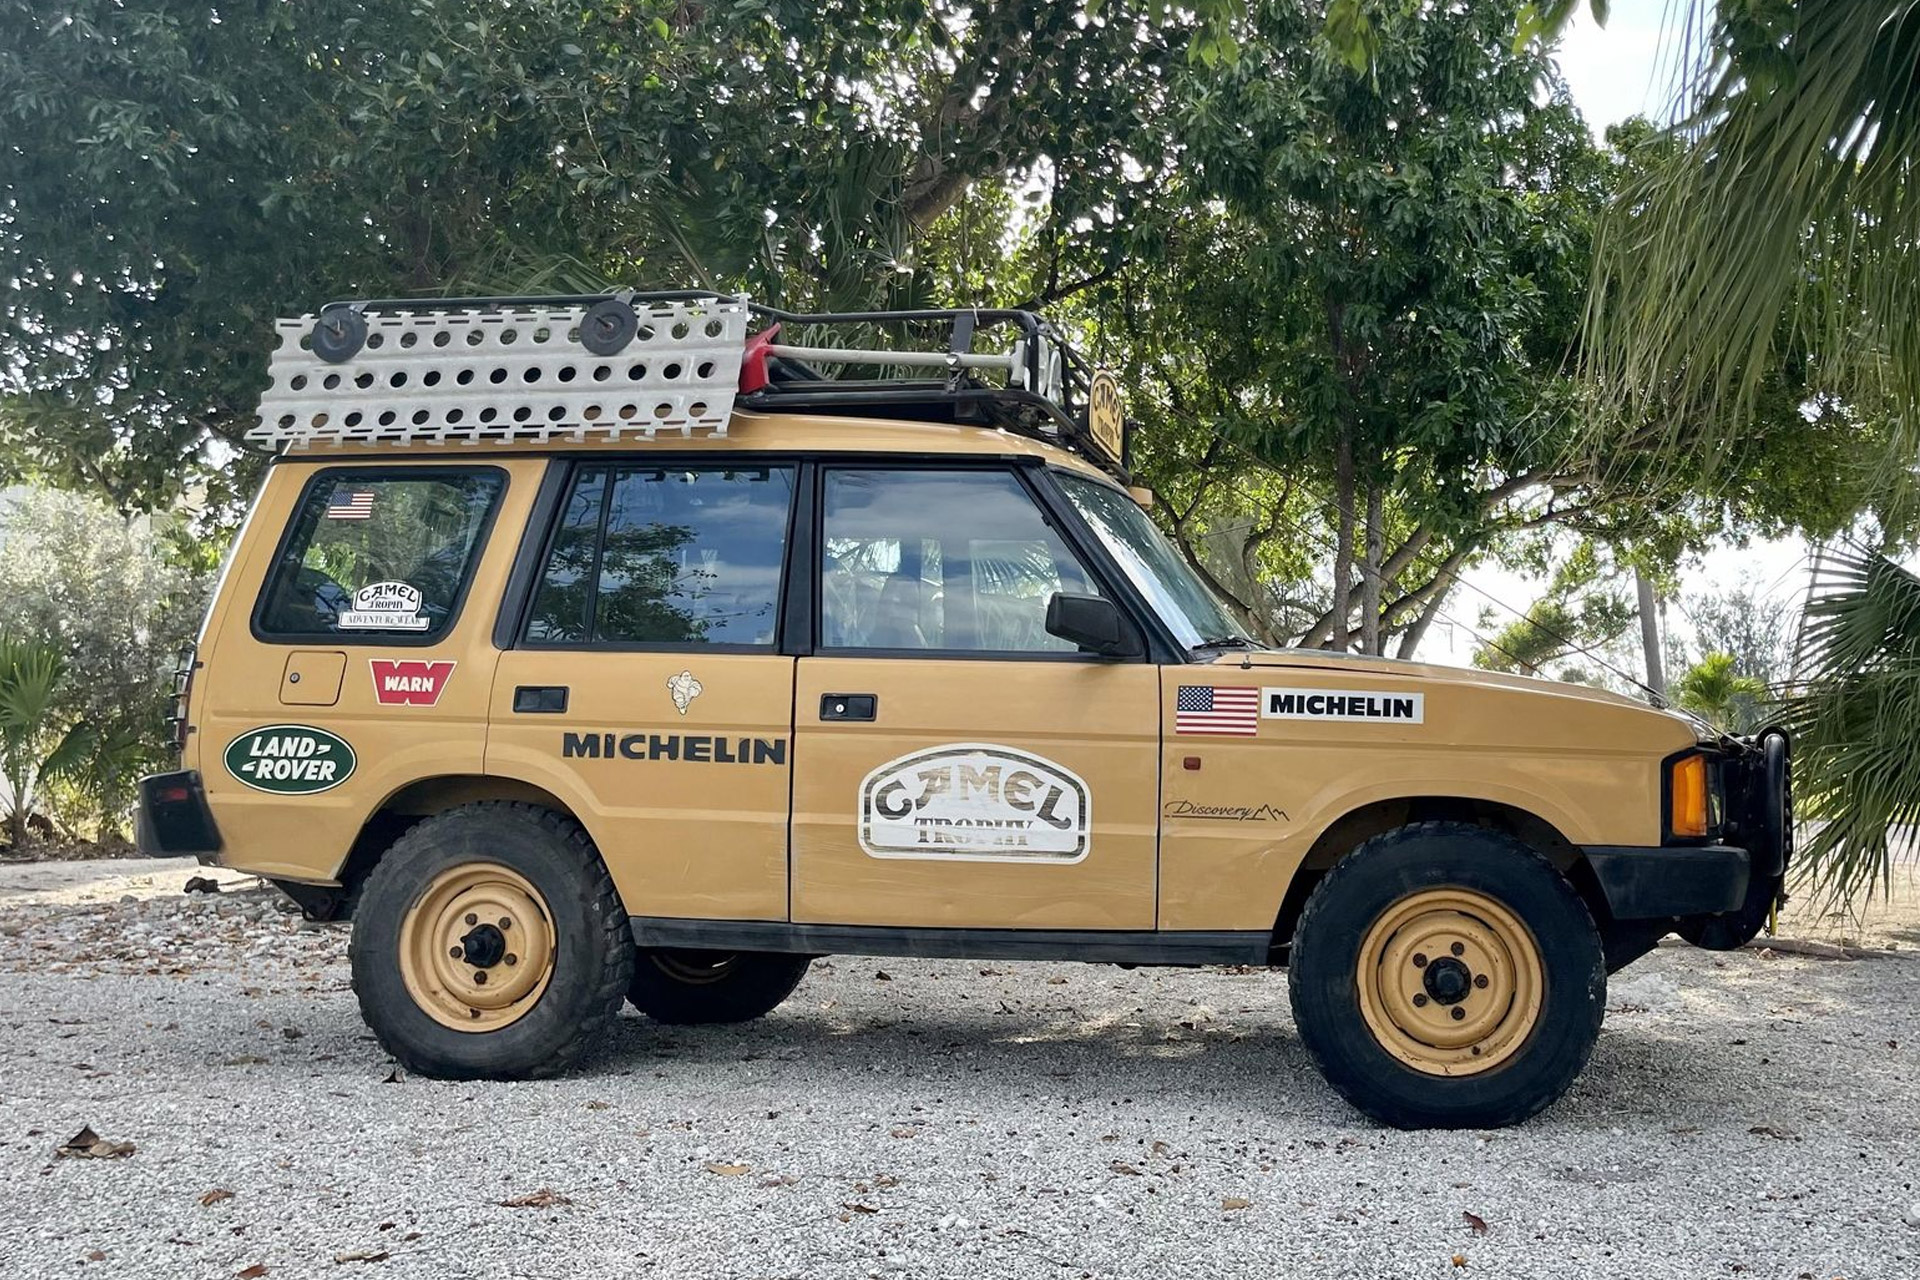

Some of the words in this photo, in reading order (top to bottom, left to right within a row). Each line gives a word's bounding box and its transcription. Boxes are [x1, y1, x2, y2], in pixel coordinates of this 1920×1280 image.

[359, 584, 417, 603] CAMEL
[385, 676, 434, 692] WARN
[1270, 694, 1414, 718] MICHELIN
[562, 732, 787, 765] MICHELIN
[875, 764, 1072, 830] CAMEL
[1164, 799, 1252, 821] Discovery
